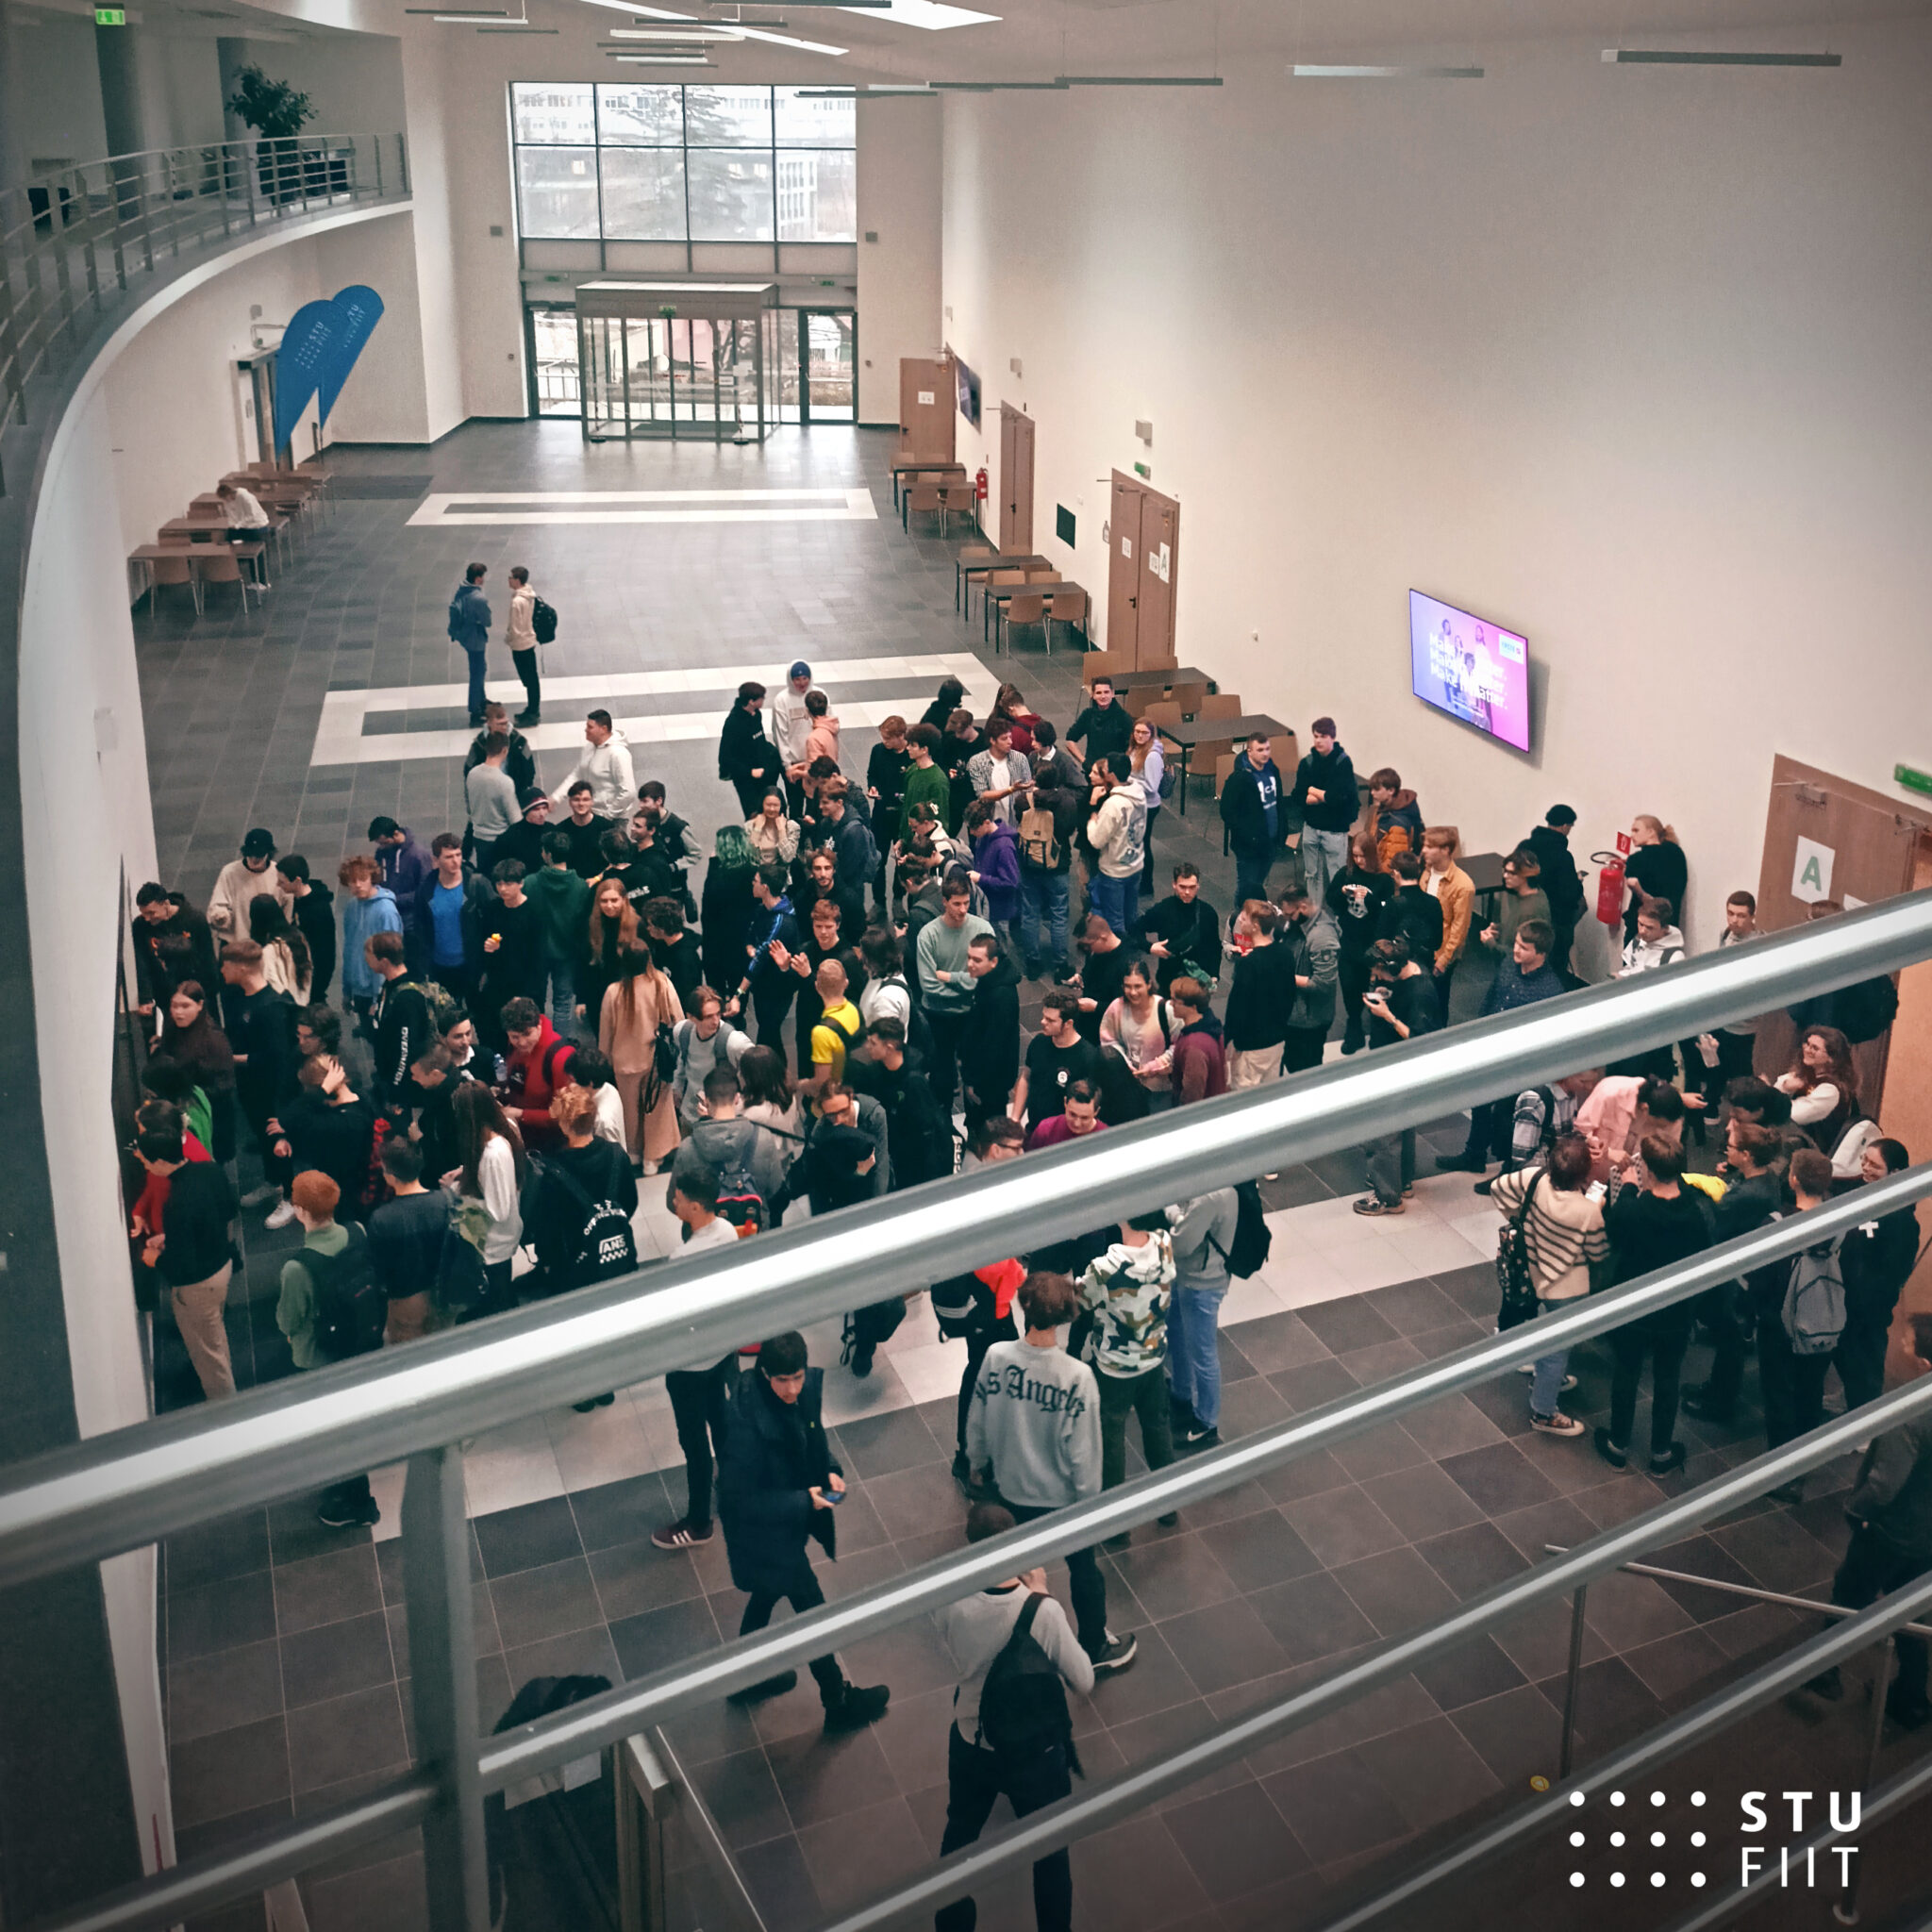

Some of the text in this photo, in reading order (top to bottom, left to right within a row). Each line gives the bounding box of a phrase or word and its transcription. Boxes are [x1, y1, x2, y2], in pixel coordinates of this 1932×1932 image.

[308, 321, 325, 341] STU
[1161, 552, 1168, 574] A
[1429, 660, 1458, 688] Make
[1800, 856, 1822, 891] A
[599, 1234, 626, 1255] VANS
